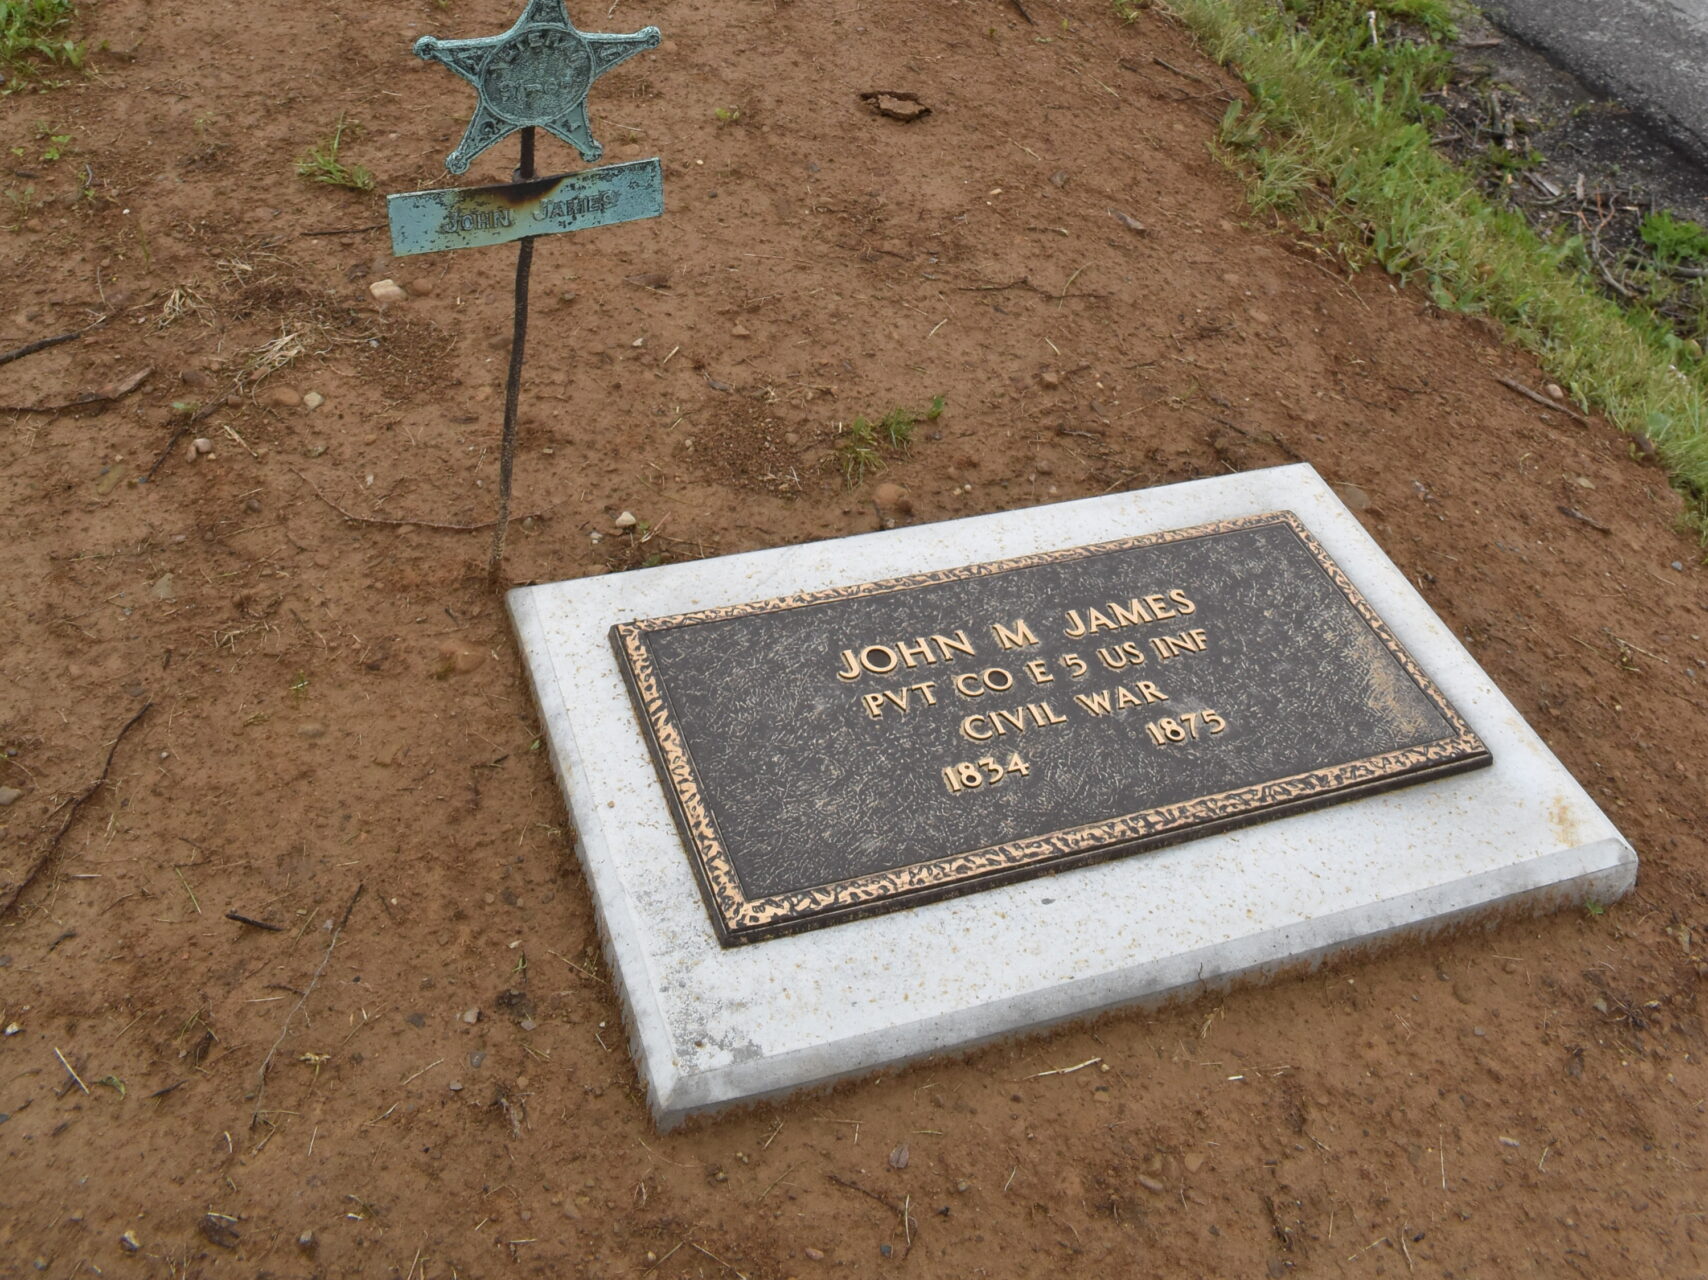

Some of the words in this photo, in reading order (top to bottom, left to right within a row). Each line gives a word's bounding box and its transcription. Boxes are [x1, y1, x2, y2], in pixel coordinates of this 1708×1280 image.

[445, 207, 513, 234] JOHN
[837, 629, 976, 681] JOHN
[993, 619, 1039, 651] M
[1065, 588, 1197, 639] JAMES
[863, 681, 938, 718] PVT
[955, 667, 1014, 698] CO
[1026, 659, 1054, 685] E
[1061, 653, 1088, 679] 5
[1098, 641, 1145, 671] US
[1151, 628, 1210, 661] INF
[962, 701, 1067, 743] CIVIL
[1075, 680, 1169, 717] WAR
[1145, 708, 1227, 747] 1875
[941, 752, 1030, 794] 1834
